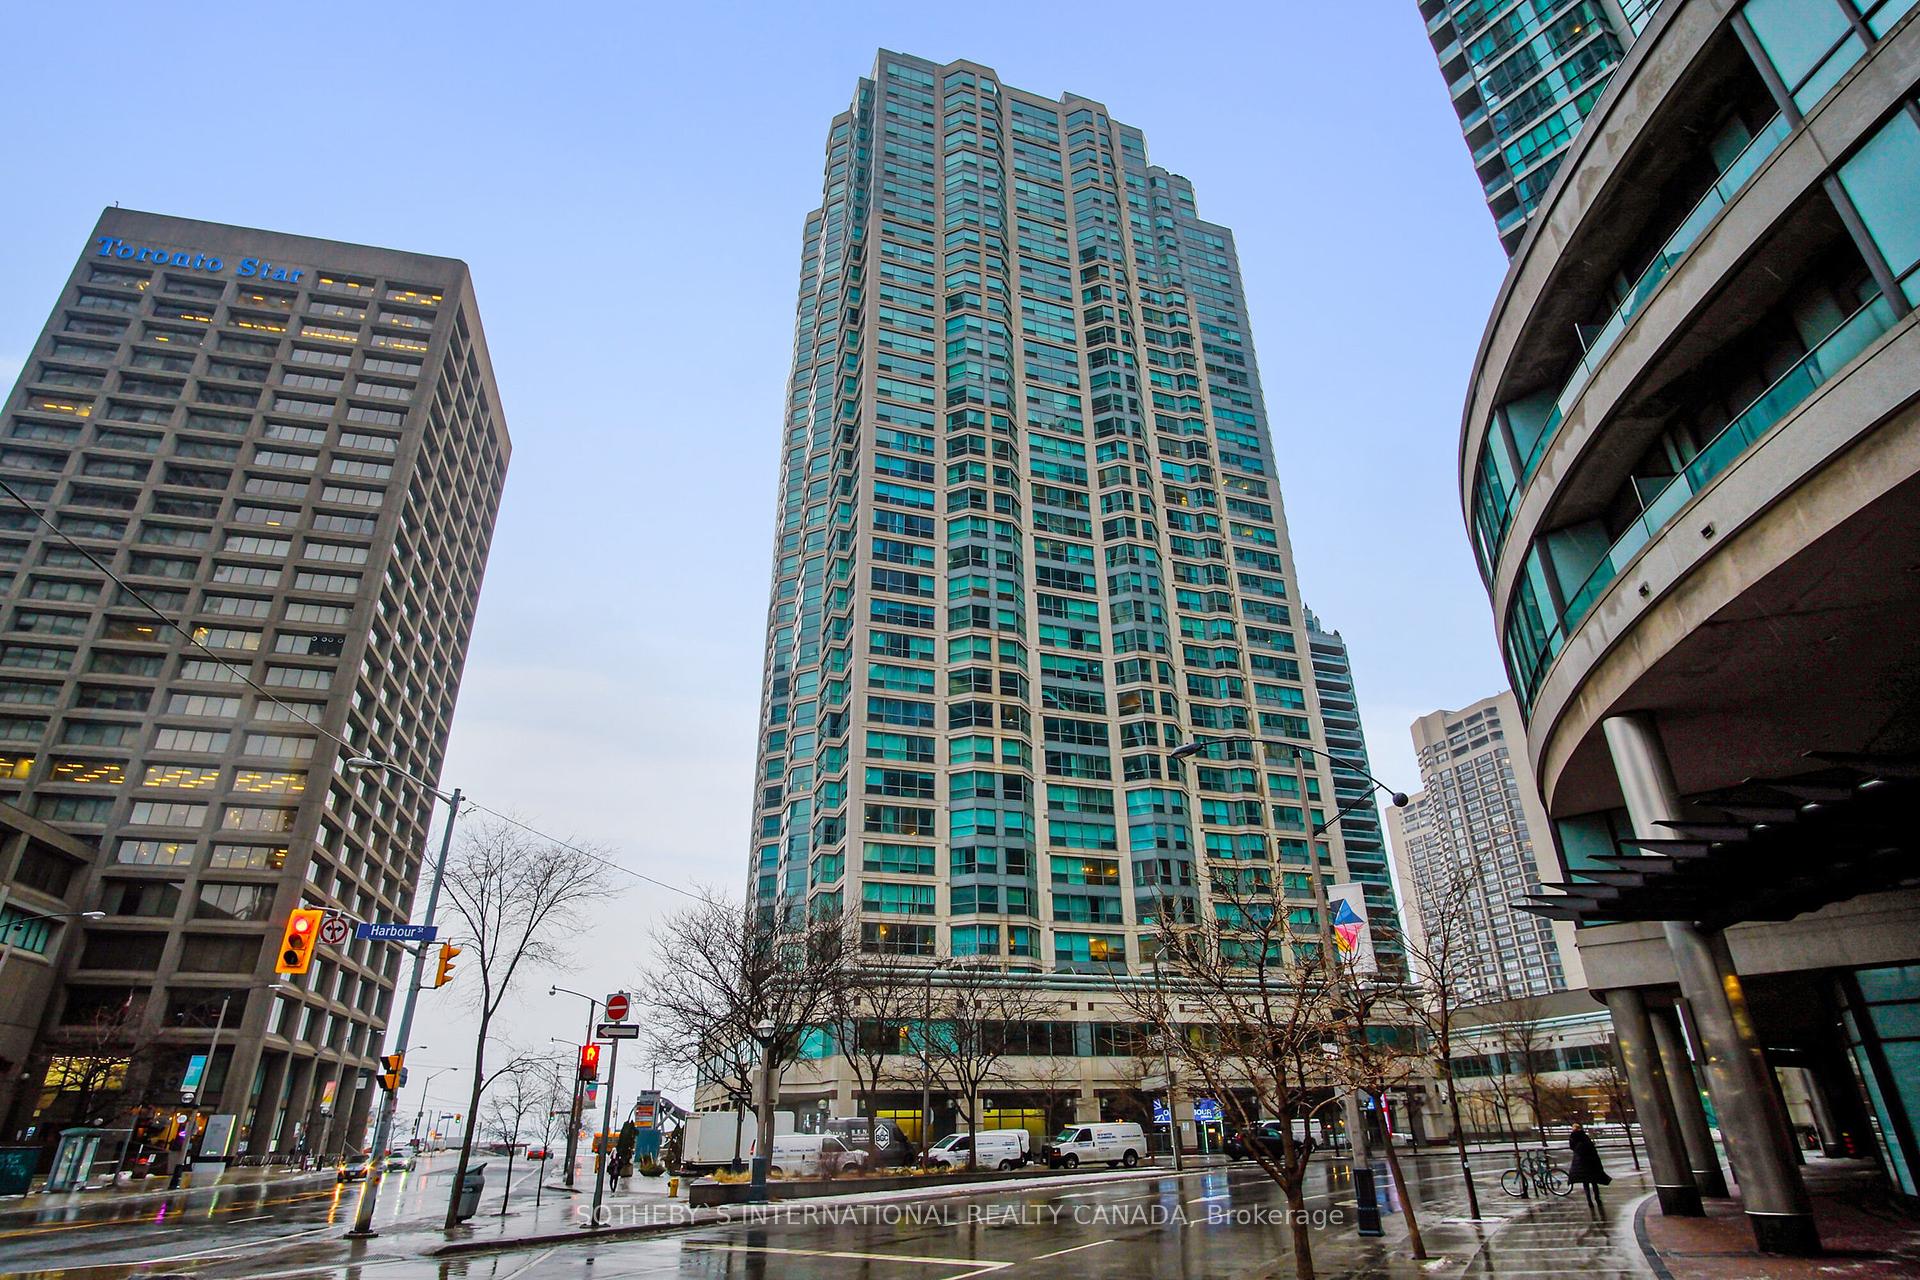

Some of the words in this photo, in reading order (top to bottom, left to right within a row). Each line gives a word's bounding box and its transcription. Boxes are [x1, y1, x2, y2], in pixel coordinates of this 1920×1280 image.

[97, 236, 224, 272] Toronto
[235, 256, 305, 284] Star
[370, 924, 417, 937] Harbour
